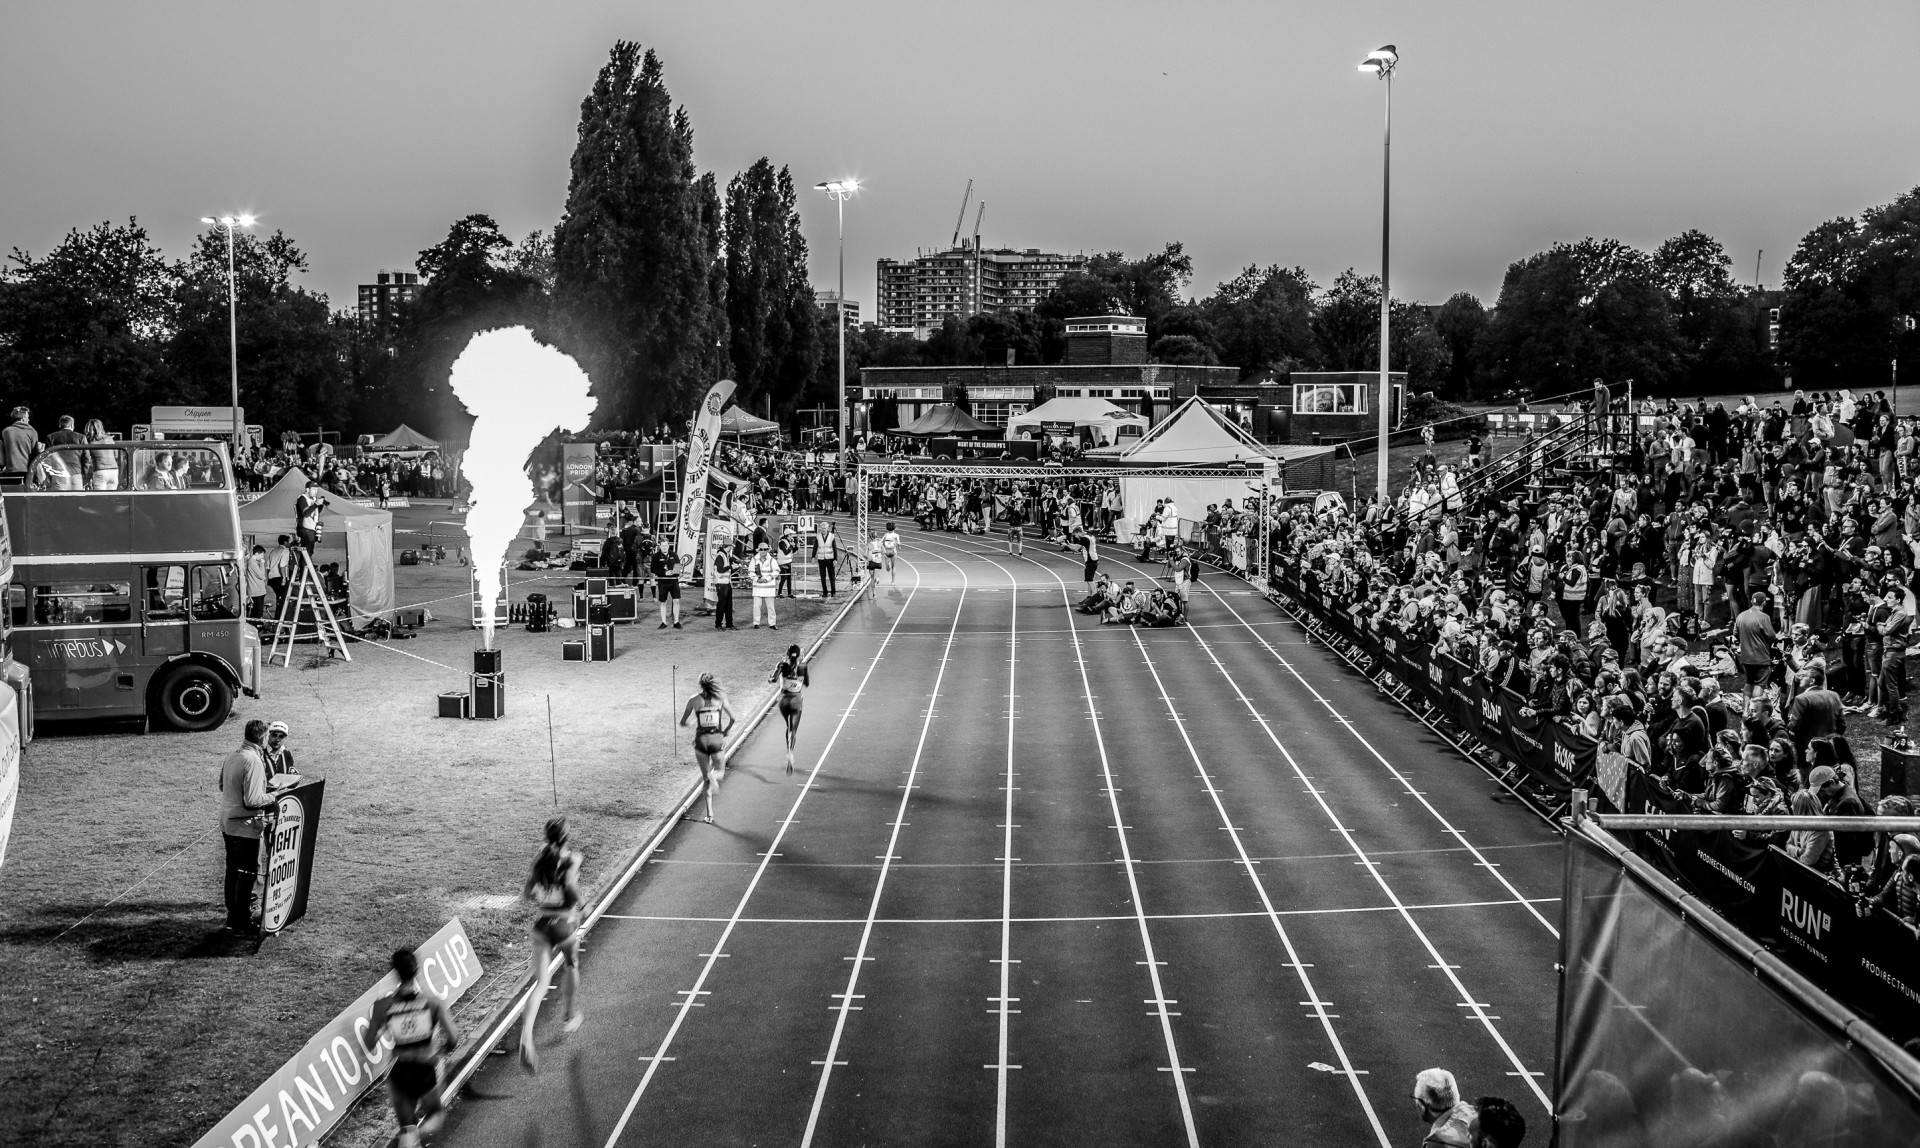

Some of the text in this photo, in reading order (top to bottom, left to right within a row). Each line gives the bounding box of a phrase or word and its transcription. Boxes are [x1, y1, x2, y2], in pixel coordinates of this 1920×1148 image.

[202, 630, 230, 639] RM 450
[1697, 849, 1756, 894] PRODIRECTRUNNING.COM
[1781, 887, 1822, 940] RUN
[1789, 932, 1806, 947] DIRECT
[422, 933, 470, 1001] CUP
